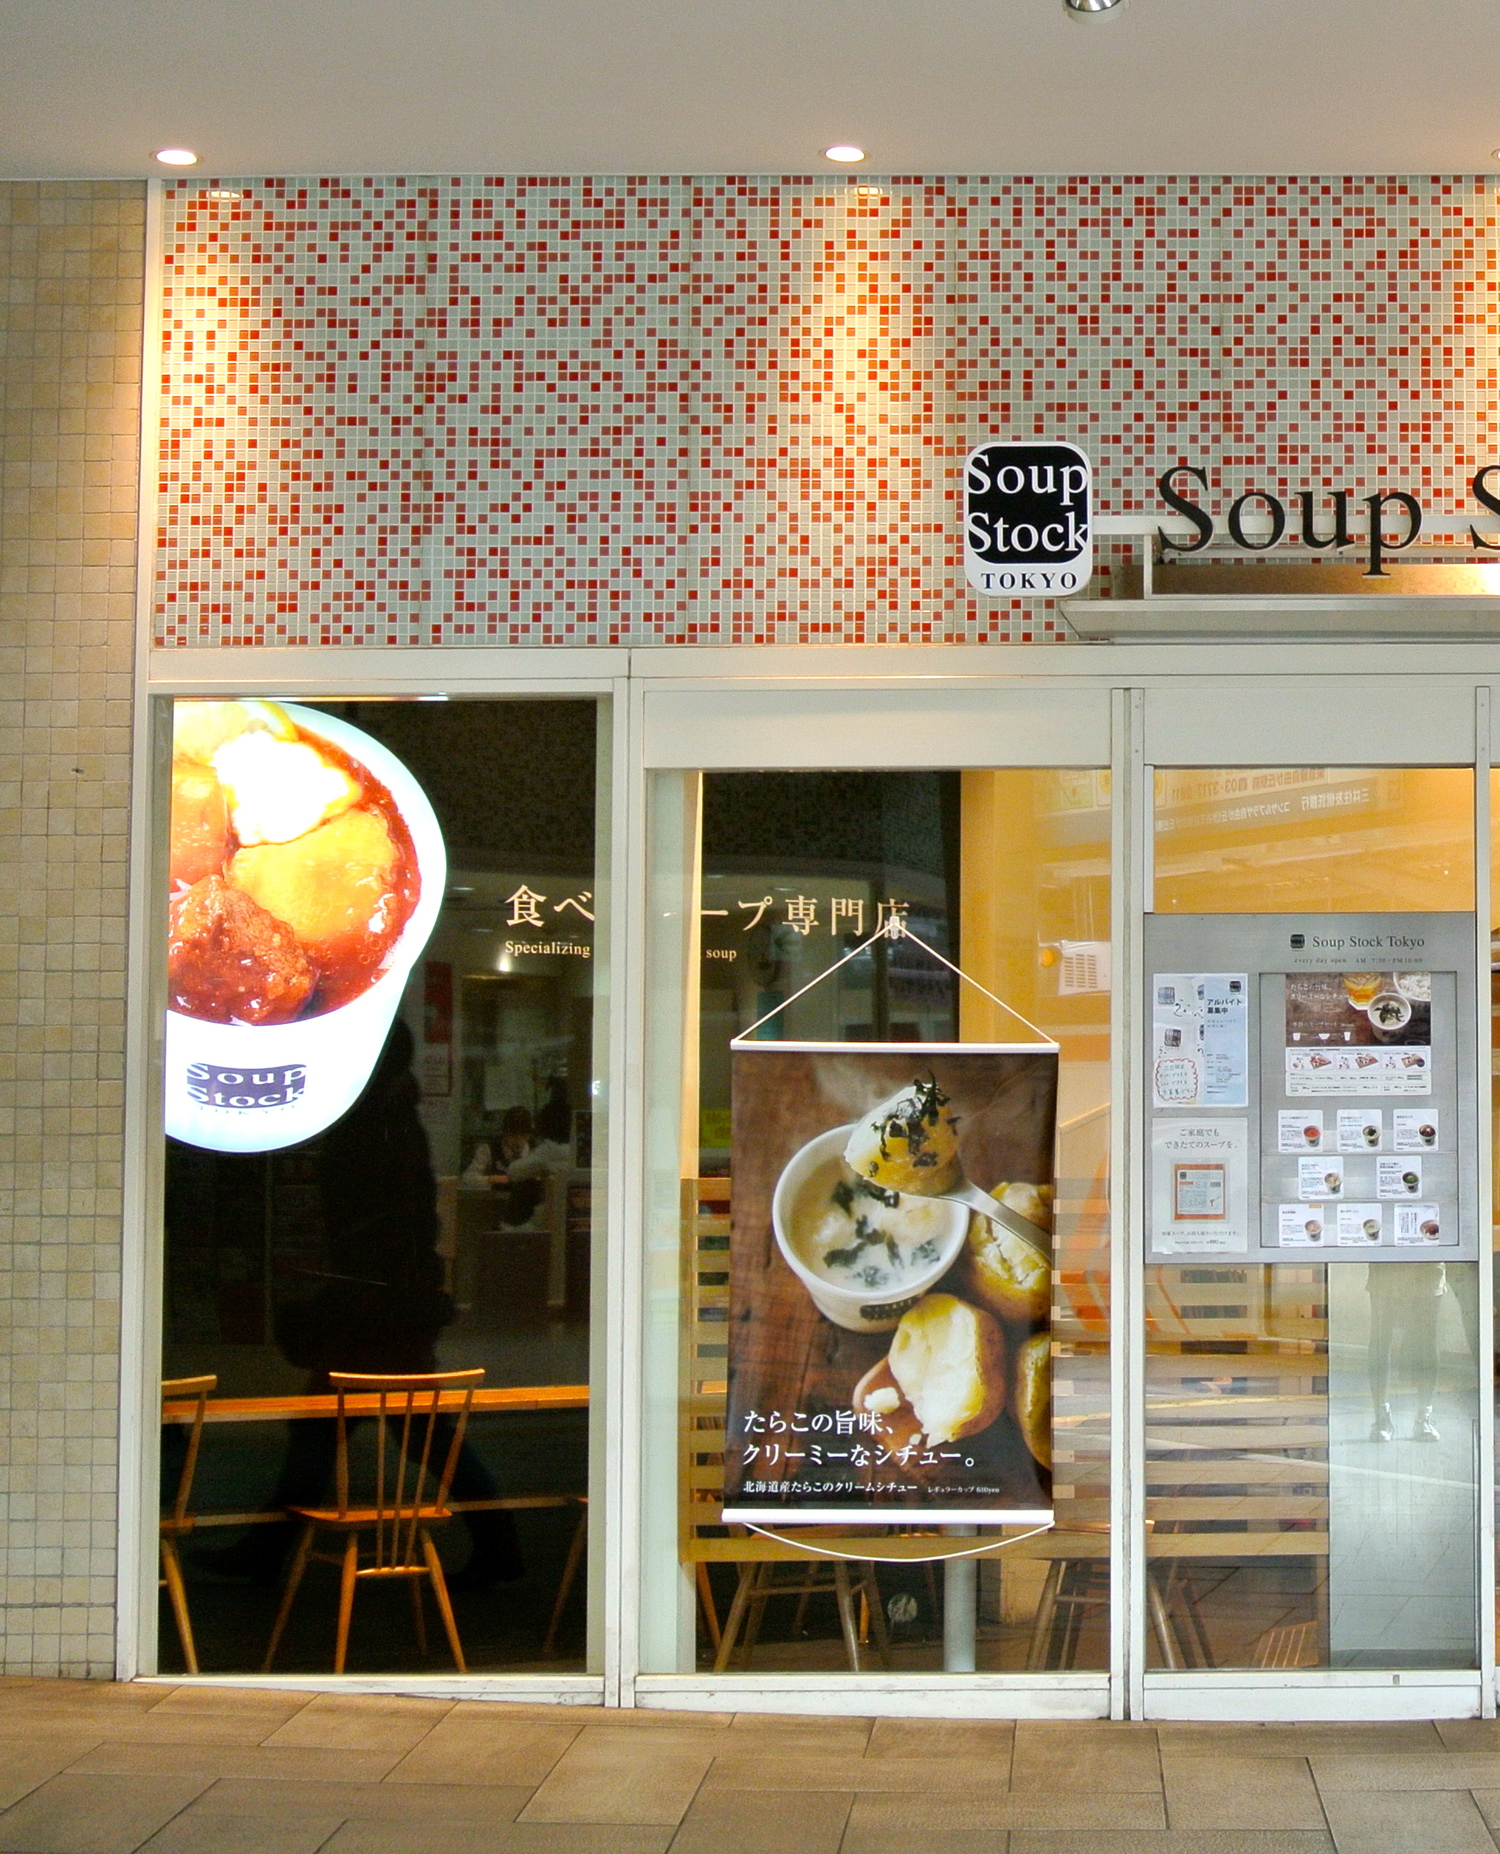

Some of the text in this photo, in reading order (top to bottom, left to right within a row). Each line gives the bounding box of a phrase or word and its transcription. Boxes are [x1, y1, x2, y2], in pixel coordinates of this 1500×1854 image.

[968, 454, 1089, 506] Soup
[1158, 466, 1422, 576] Soup
[968, 511, 1089, 553] Stock
[980, 572, 1077, 590] TOKYO
[504, 941, 737, 962] Specializing soup
[1312, 936, 1345, 951] Soup
[1349, 935, 1384, 948] Stock
[1386, 935, 1425, 951] Tokyo
[1315, 957, 1327, 965] day
[1207, 998, 1241, 1006] アルバイト
[187, 1062, 307, 1086] Soup
[187, 1086, 305, 1107] Stock
[1179, 1128, 1220, 1138] ご家庭でも
[743, 1409, 894, 1436] たらこの旨味、
[742, 1443, 975, 1468] クリーミーなシチュー。
[742, 1480, 918, 1494] 北海道産たらこのクリームシチュー
